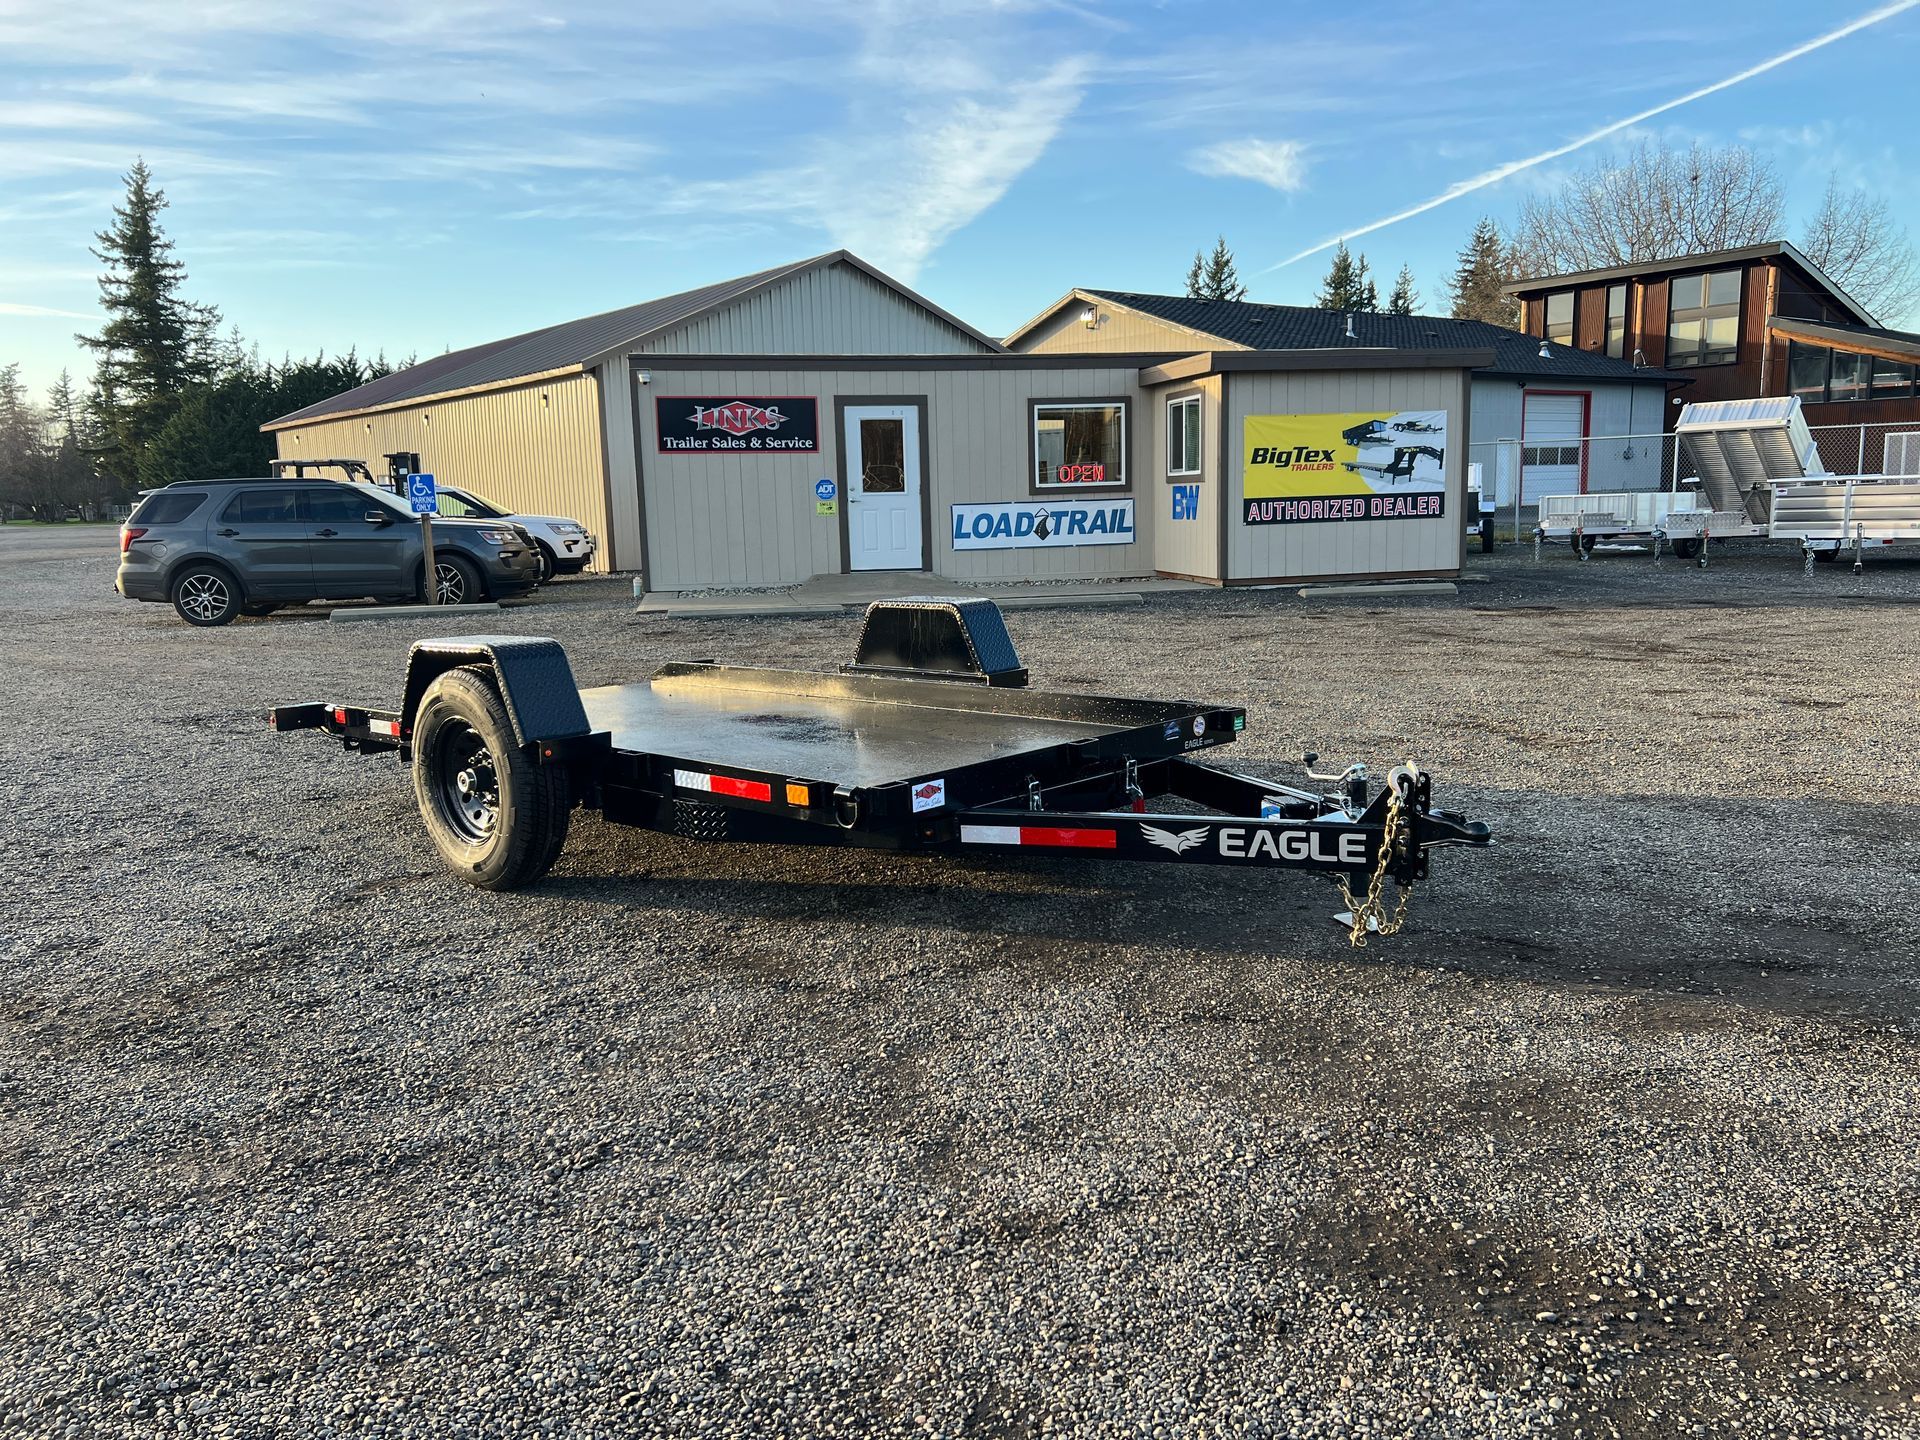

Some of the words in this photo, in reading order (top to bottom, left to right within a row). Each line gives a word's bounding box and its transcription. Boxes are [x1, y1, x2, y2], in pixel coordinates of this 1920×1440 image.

[694, 405, 781, 431] LINKS
[664, 437, 709, 449] Trailer
[712, 437, 747, 449] Sales
[750, 437, 762, 449] &
[765, 436, 813, 449] Service
[1059, 465, 1105, 482] OPEN
[1291, 463, 1335, 472] TRAILERS
[817, 484, 834, 494] ADT
[411, 496, 436, 505] PARKING
[416, 503, 432, 512] ONLY
[1247, 498, 1365, 522] AUTHORIZED
[1370, 495, 1440, 517] DEALER
[954, 511, 1035, 540] LOAD
[1050, 508, 1133, 536] TRAIL
[1184, 737, 1204, 749] EAGLE
[1219, 828, 1367, 864] EAGLE
